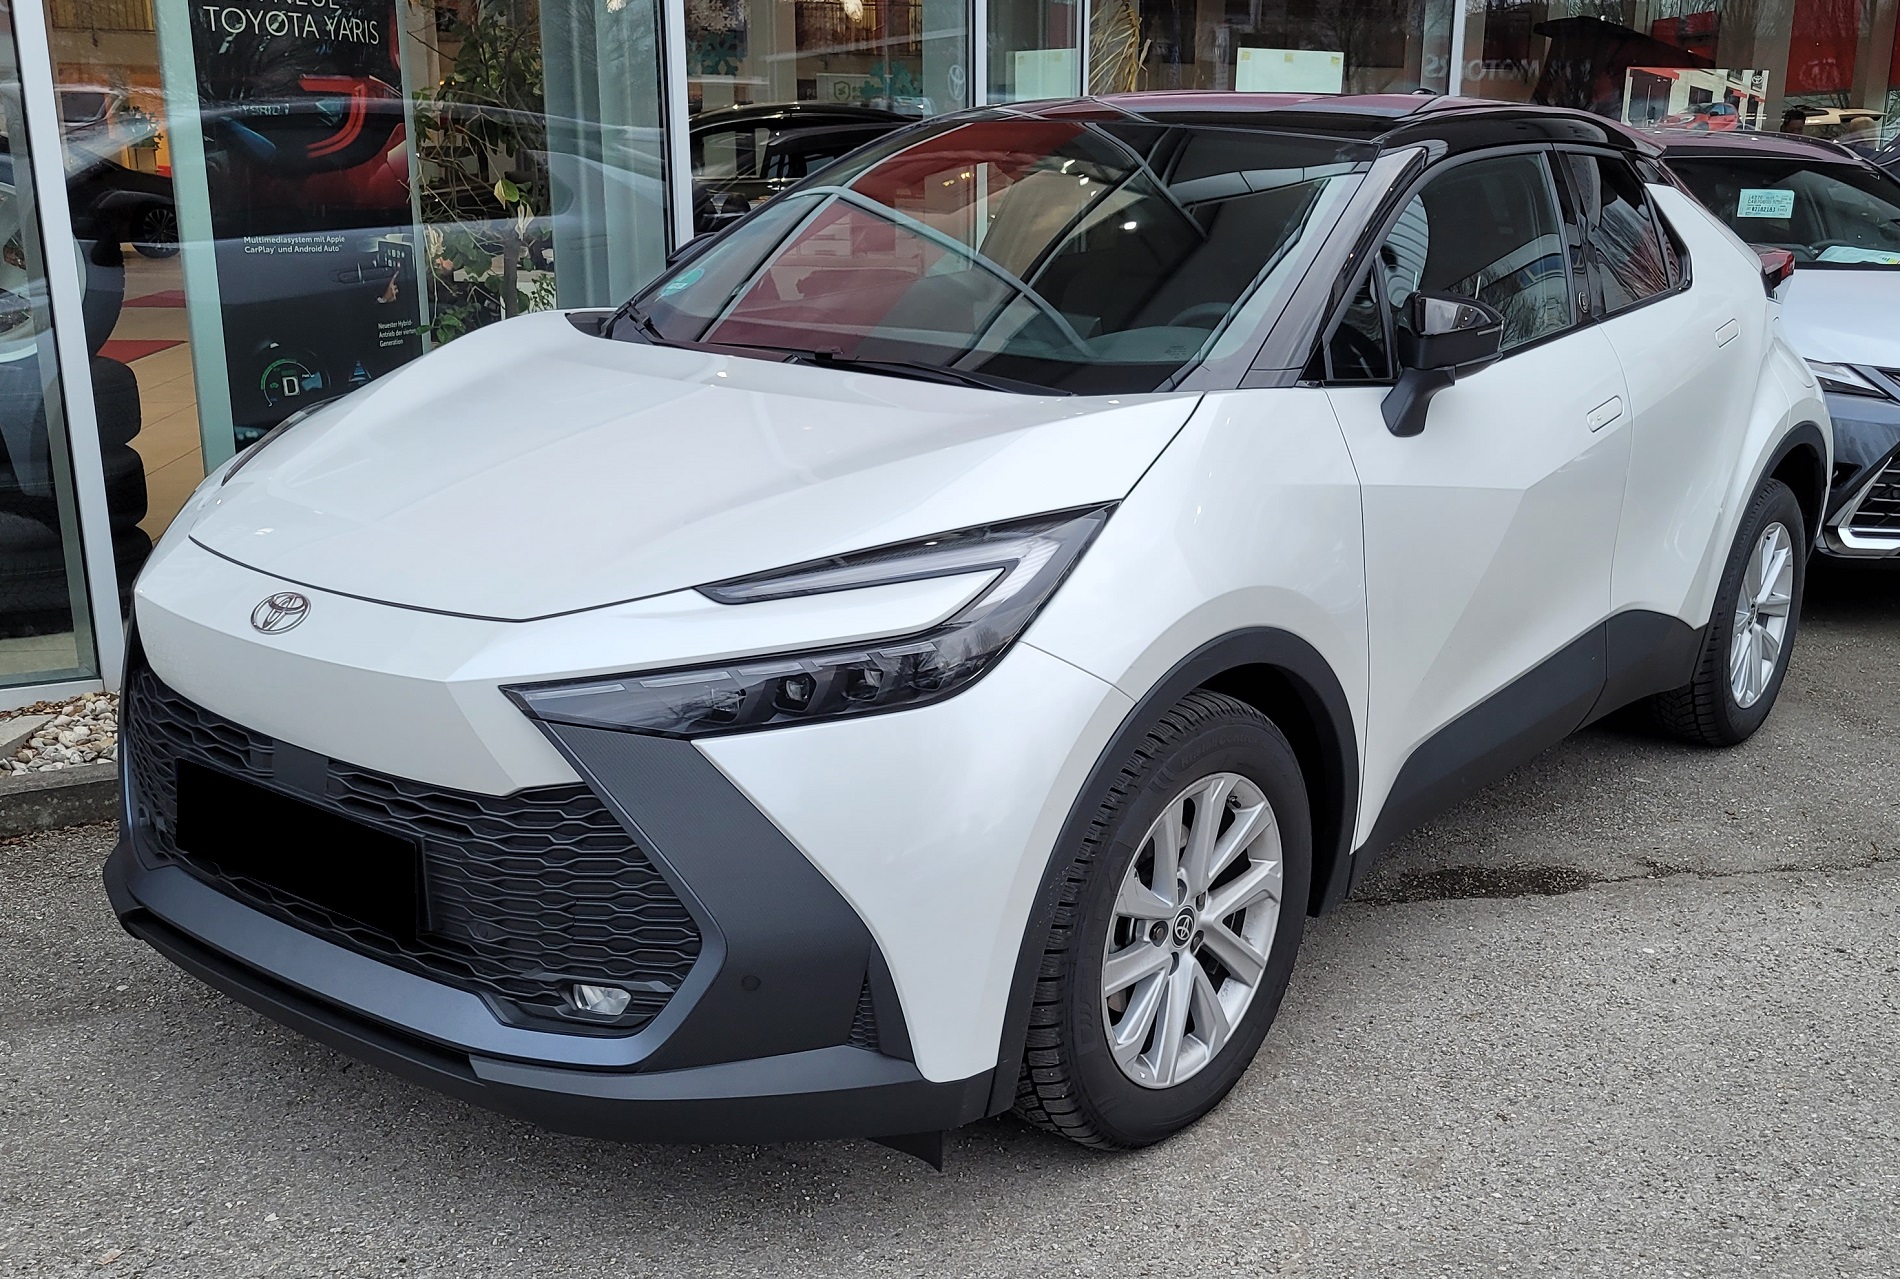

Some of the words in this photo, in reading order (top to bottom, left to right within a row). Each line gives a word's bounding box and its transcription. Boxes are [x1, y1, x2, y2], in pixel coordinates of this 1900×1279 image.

[203, 6, 319, 39] TOYOTA
[324, 15, 379, 45] YARIS
[243, 235, 313, 245] Multimediasystem
[313, 235, 326, 243] mit
[326, 234, 345, 243] Apple
[277, 245, 293, 253] und
[293, 244, 322, 253] Android
